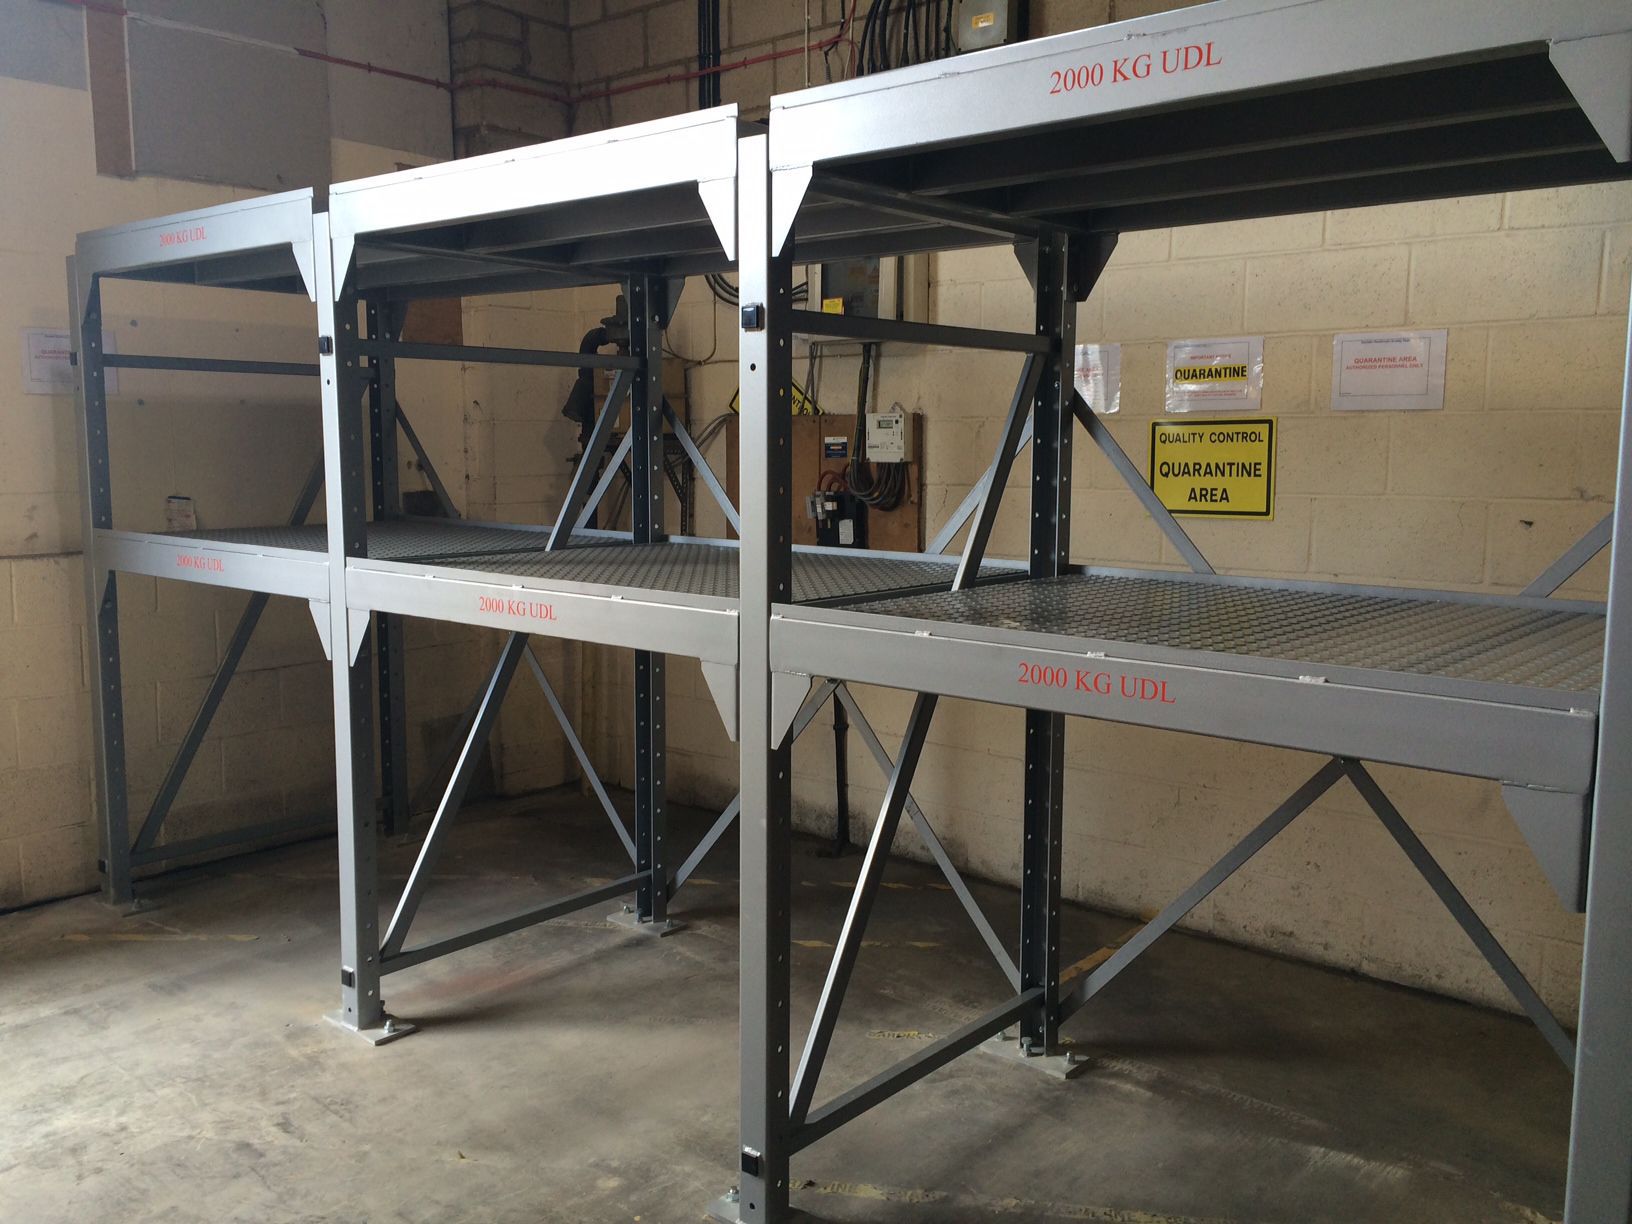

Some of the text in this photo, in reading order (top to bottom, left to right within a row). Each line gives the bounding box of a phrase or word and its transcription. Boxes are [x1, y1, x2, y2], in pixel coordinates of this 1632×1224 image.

[1050, 41, 1223, 94] 2000 KG UDL
[191, 225, 208, 241] UDL
[1174, 365, 1247, 381] QUARANTINE
[1159, 431, 1264, 444] QUALITY CONTROL
[1159, 461, 1262, 478] QUARANTINE
[1187, 487, 1230, 503] AREA
[207, 557, 225, 572] UDL
[479, 596, 558, 621] 2000 KG UDL
[1018, 662, 1176, 704] 2000 KG UDL
